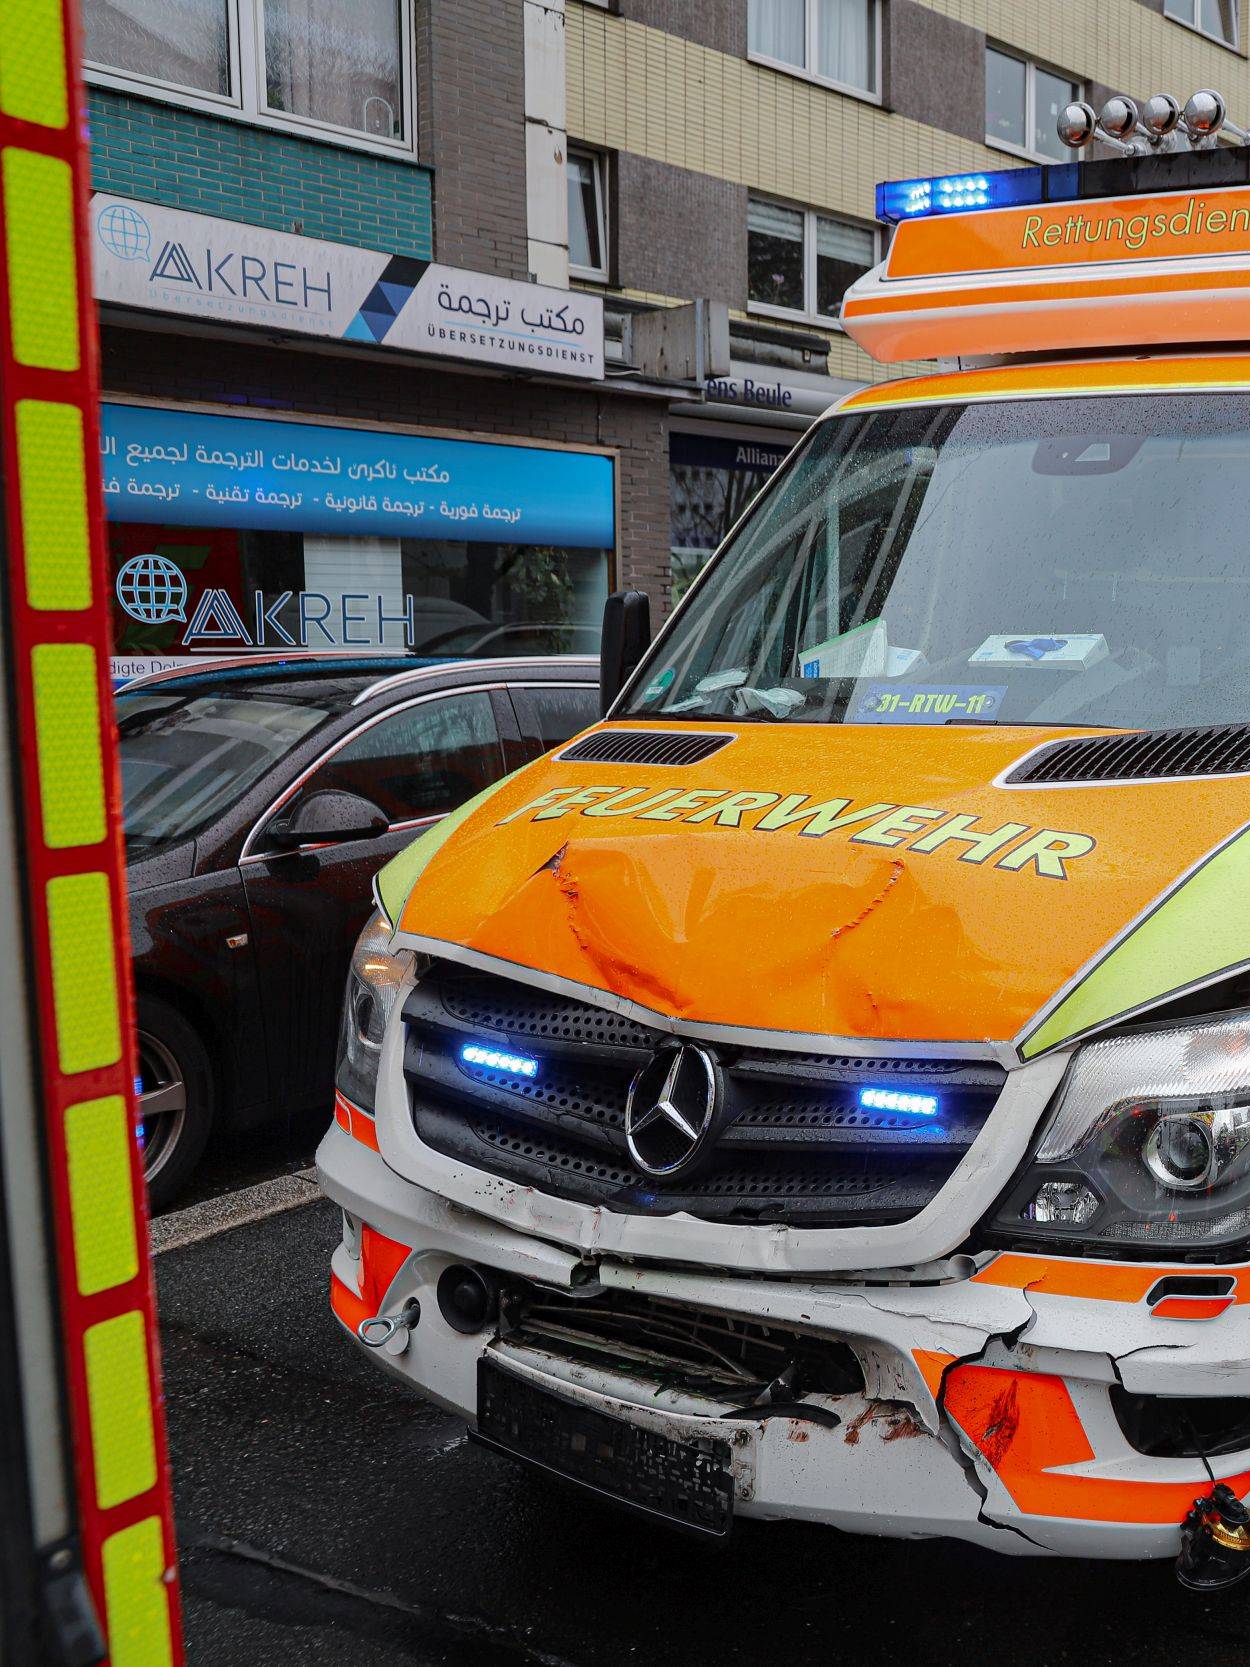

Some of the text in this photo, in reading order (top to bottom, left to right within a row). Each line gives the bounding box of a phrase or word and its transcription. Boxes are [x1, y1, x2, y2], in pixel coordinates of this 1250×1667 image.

[149, 240, 333, 312] AKREH
[437, 283, 585, 335] مكتب ترجمة
[427, 323, 595, 364] ÜBERSETZUNGSDIENST
[743, 379, 792, 407] Beule
[126, 443, 188, 467] لجميع
[195, 445, 264, 471] الترجمة
[271, 452, 341, 475] لخدمات
[403, 463, 450, 485] مكتب
[127, 477, 180, 501] ترجمة
[205, 484, 250, 504] تقنية
[255, 487, 303, 509] ترجمة
[325, 493, 377, 513] قانونية
[382, 496, 424, 517] ترجمة
[440, 502, 478, 520] فورية
[482, 503, 521, 523] ترجمة
[181, 588, 415, 646] AKREH
[876, 694, 987, 713] 31-RTW-11
[493, 785, 1098, 881] FEUERWEHR
